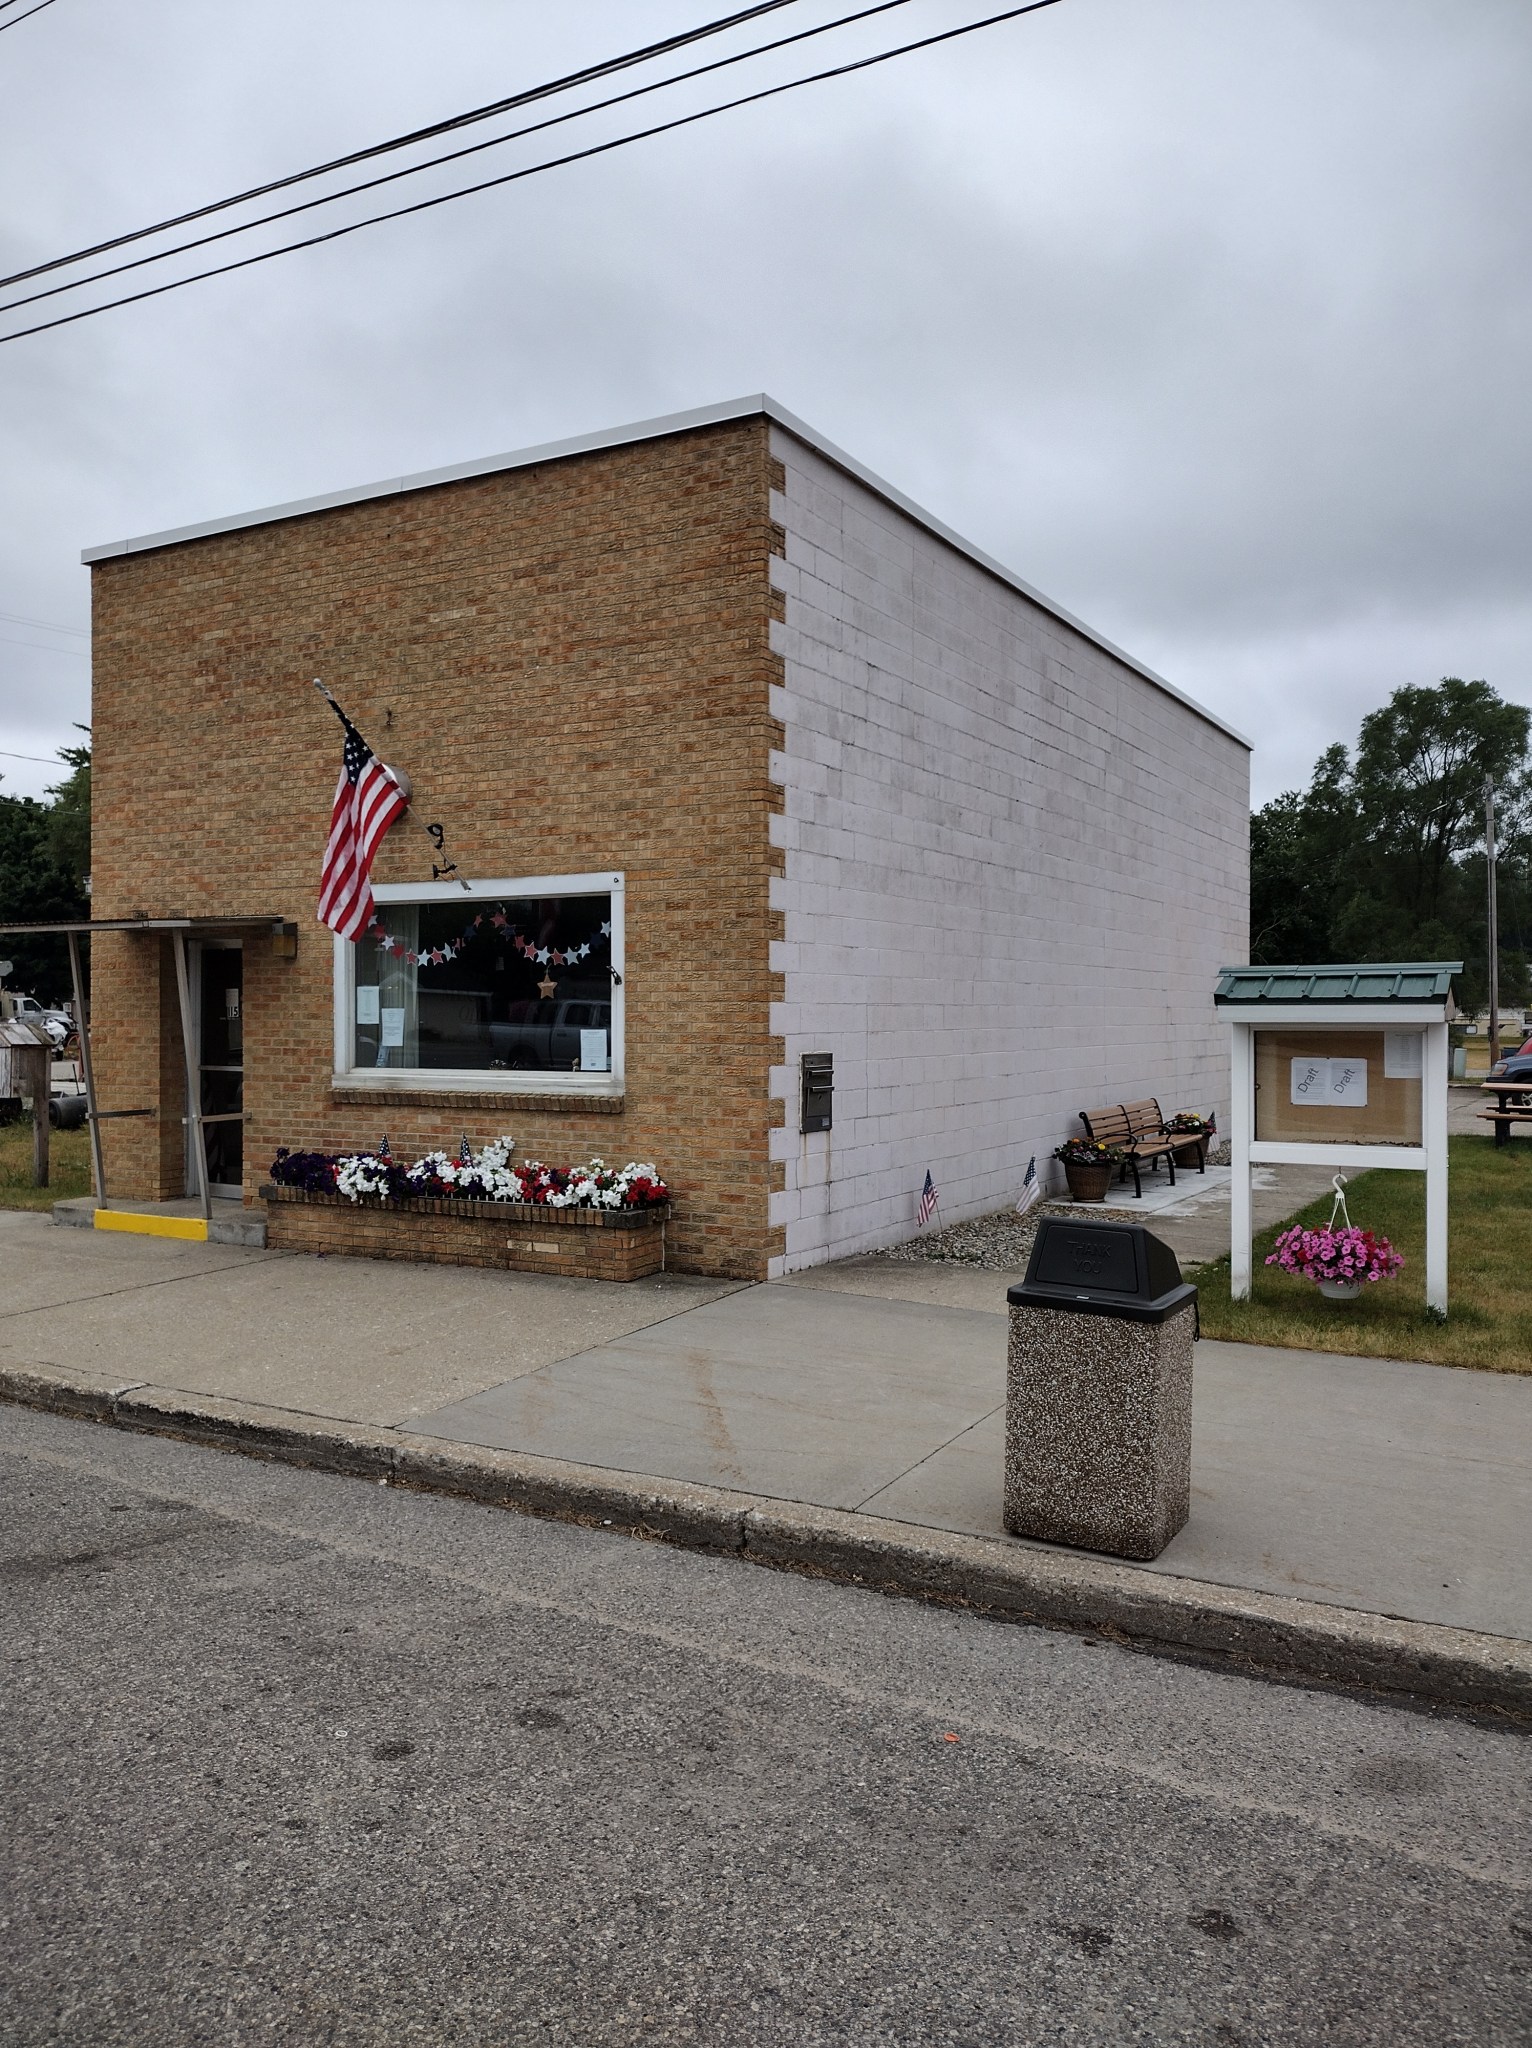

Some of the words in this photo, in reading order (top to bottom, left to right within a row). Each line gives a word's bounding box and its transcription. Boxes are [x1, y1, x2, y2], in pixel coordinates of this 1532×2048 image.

[228, 1006, 238, 1017] 115
[1297, 1067, 1319, 1093] Draft
[1333, 1068, 1356, 1094] Draft
[1067, 1240, 1112, 1258] THANK
[1074, 1258, 1102, 1274] YOU
